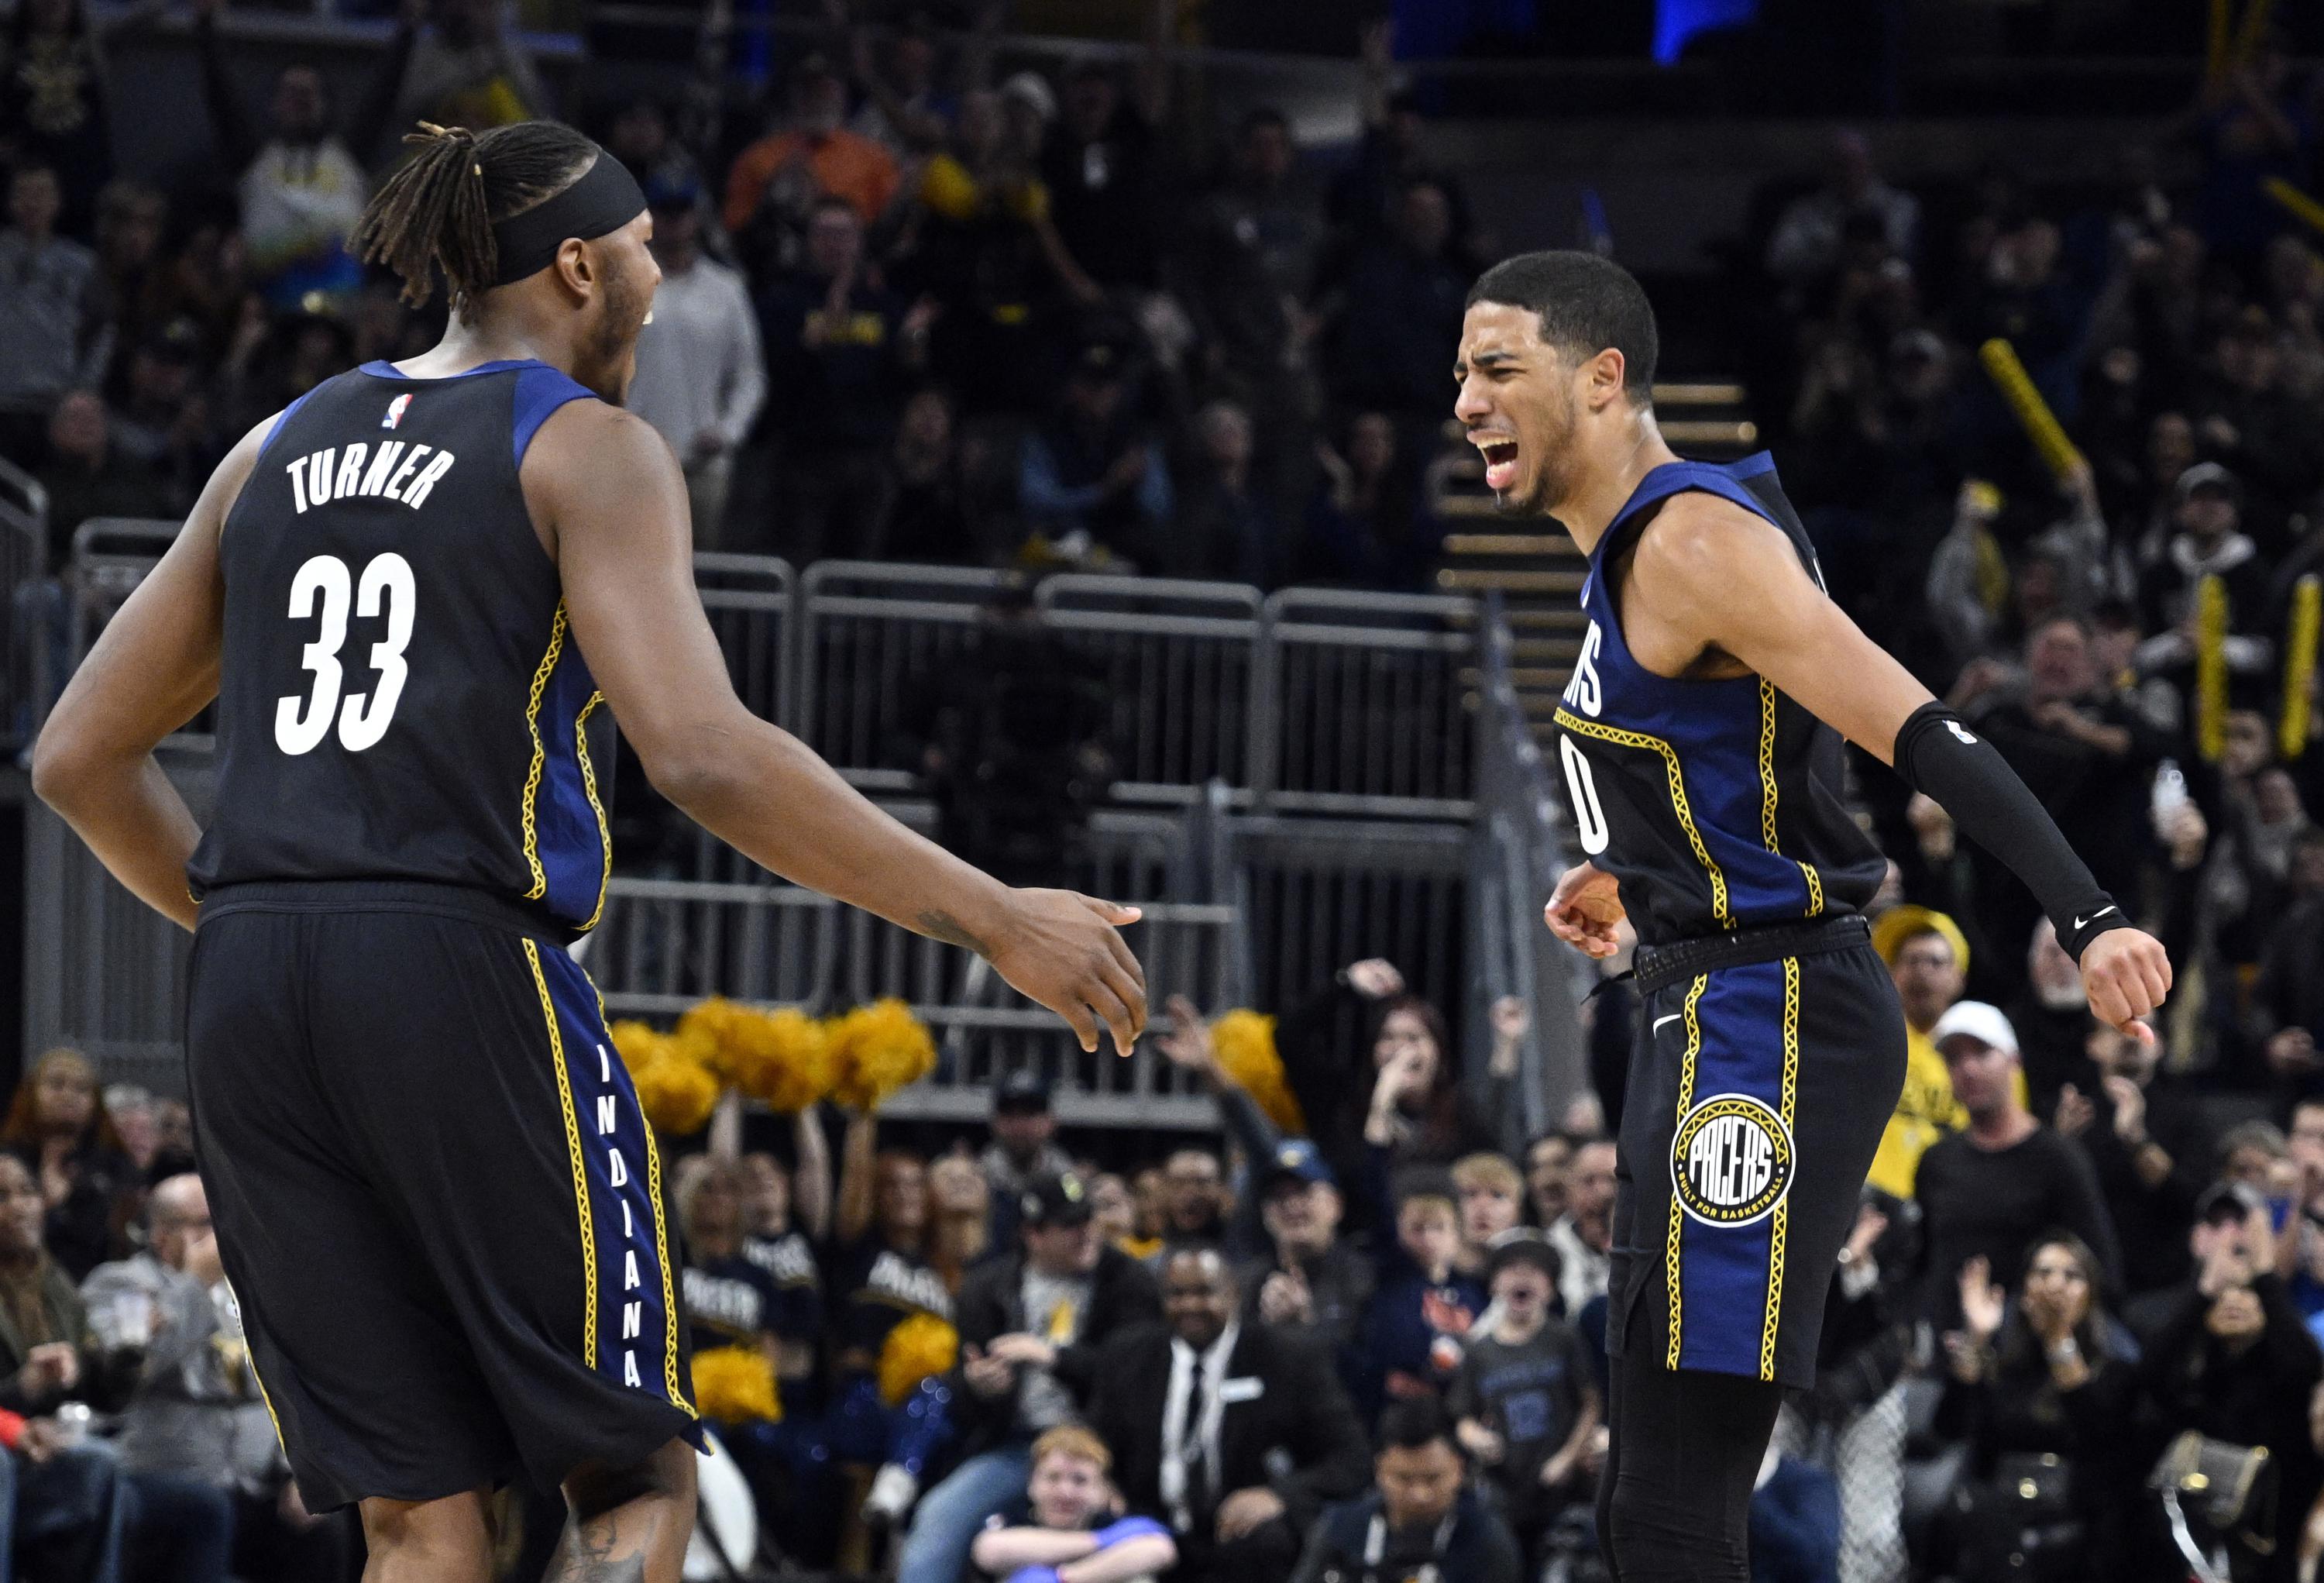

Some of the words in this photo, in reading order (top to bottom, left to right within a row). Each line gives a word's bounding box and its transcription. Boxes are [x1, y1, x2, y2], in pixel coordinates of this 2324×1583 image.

[286, 440, 456, 514] TURNER
[274, 552, 416, 755] 33
[1560, 733, 1609, 855] 0
[1678, 1172, 1697, 1203] BUILT
[1697, 1201, 1717, 1218] FOR
[1721, 1176, 1784, 1220] BASKETBALL
[1689, 1115, 1773, 1206] PACERS
[596, 1043, 642, 1389] INDIANA
